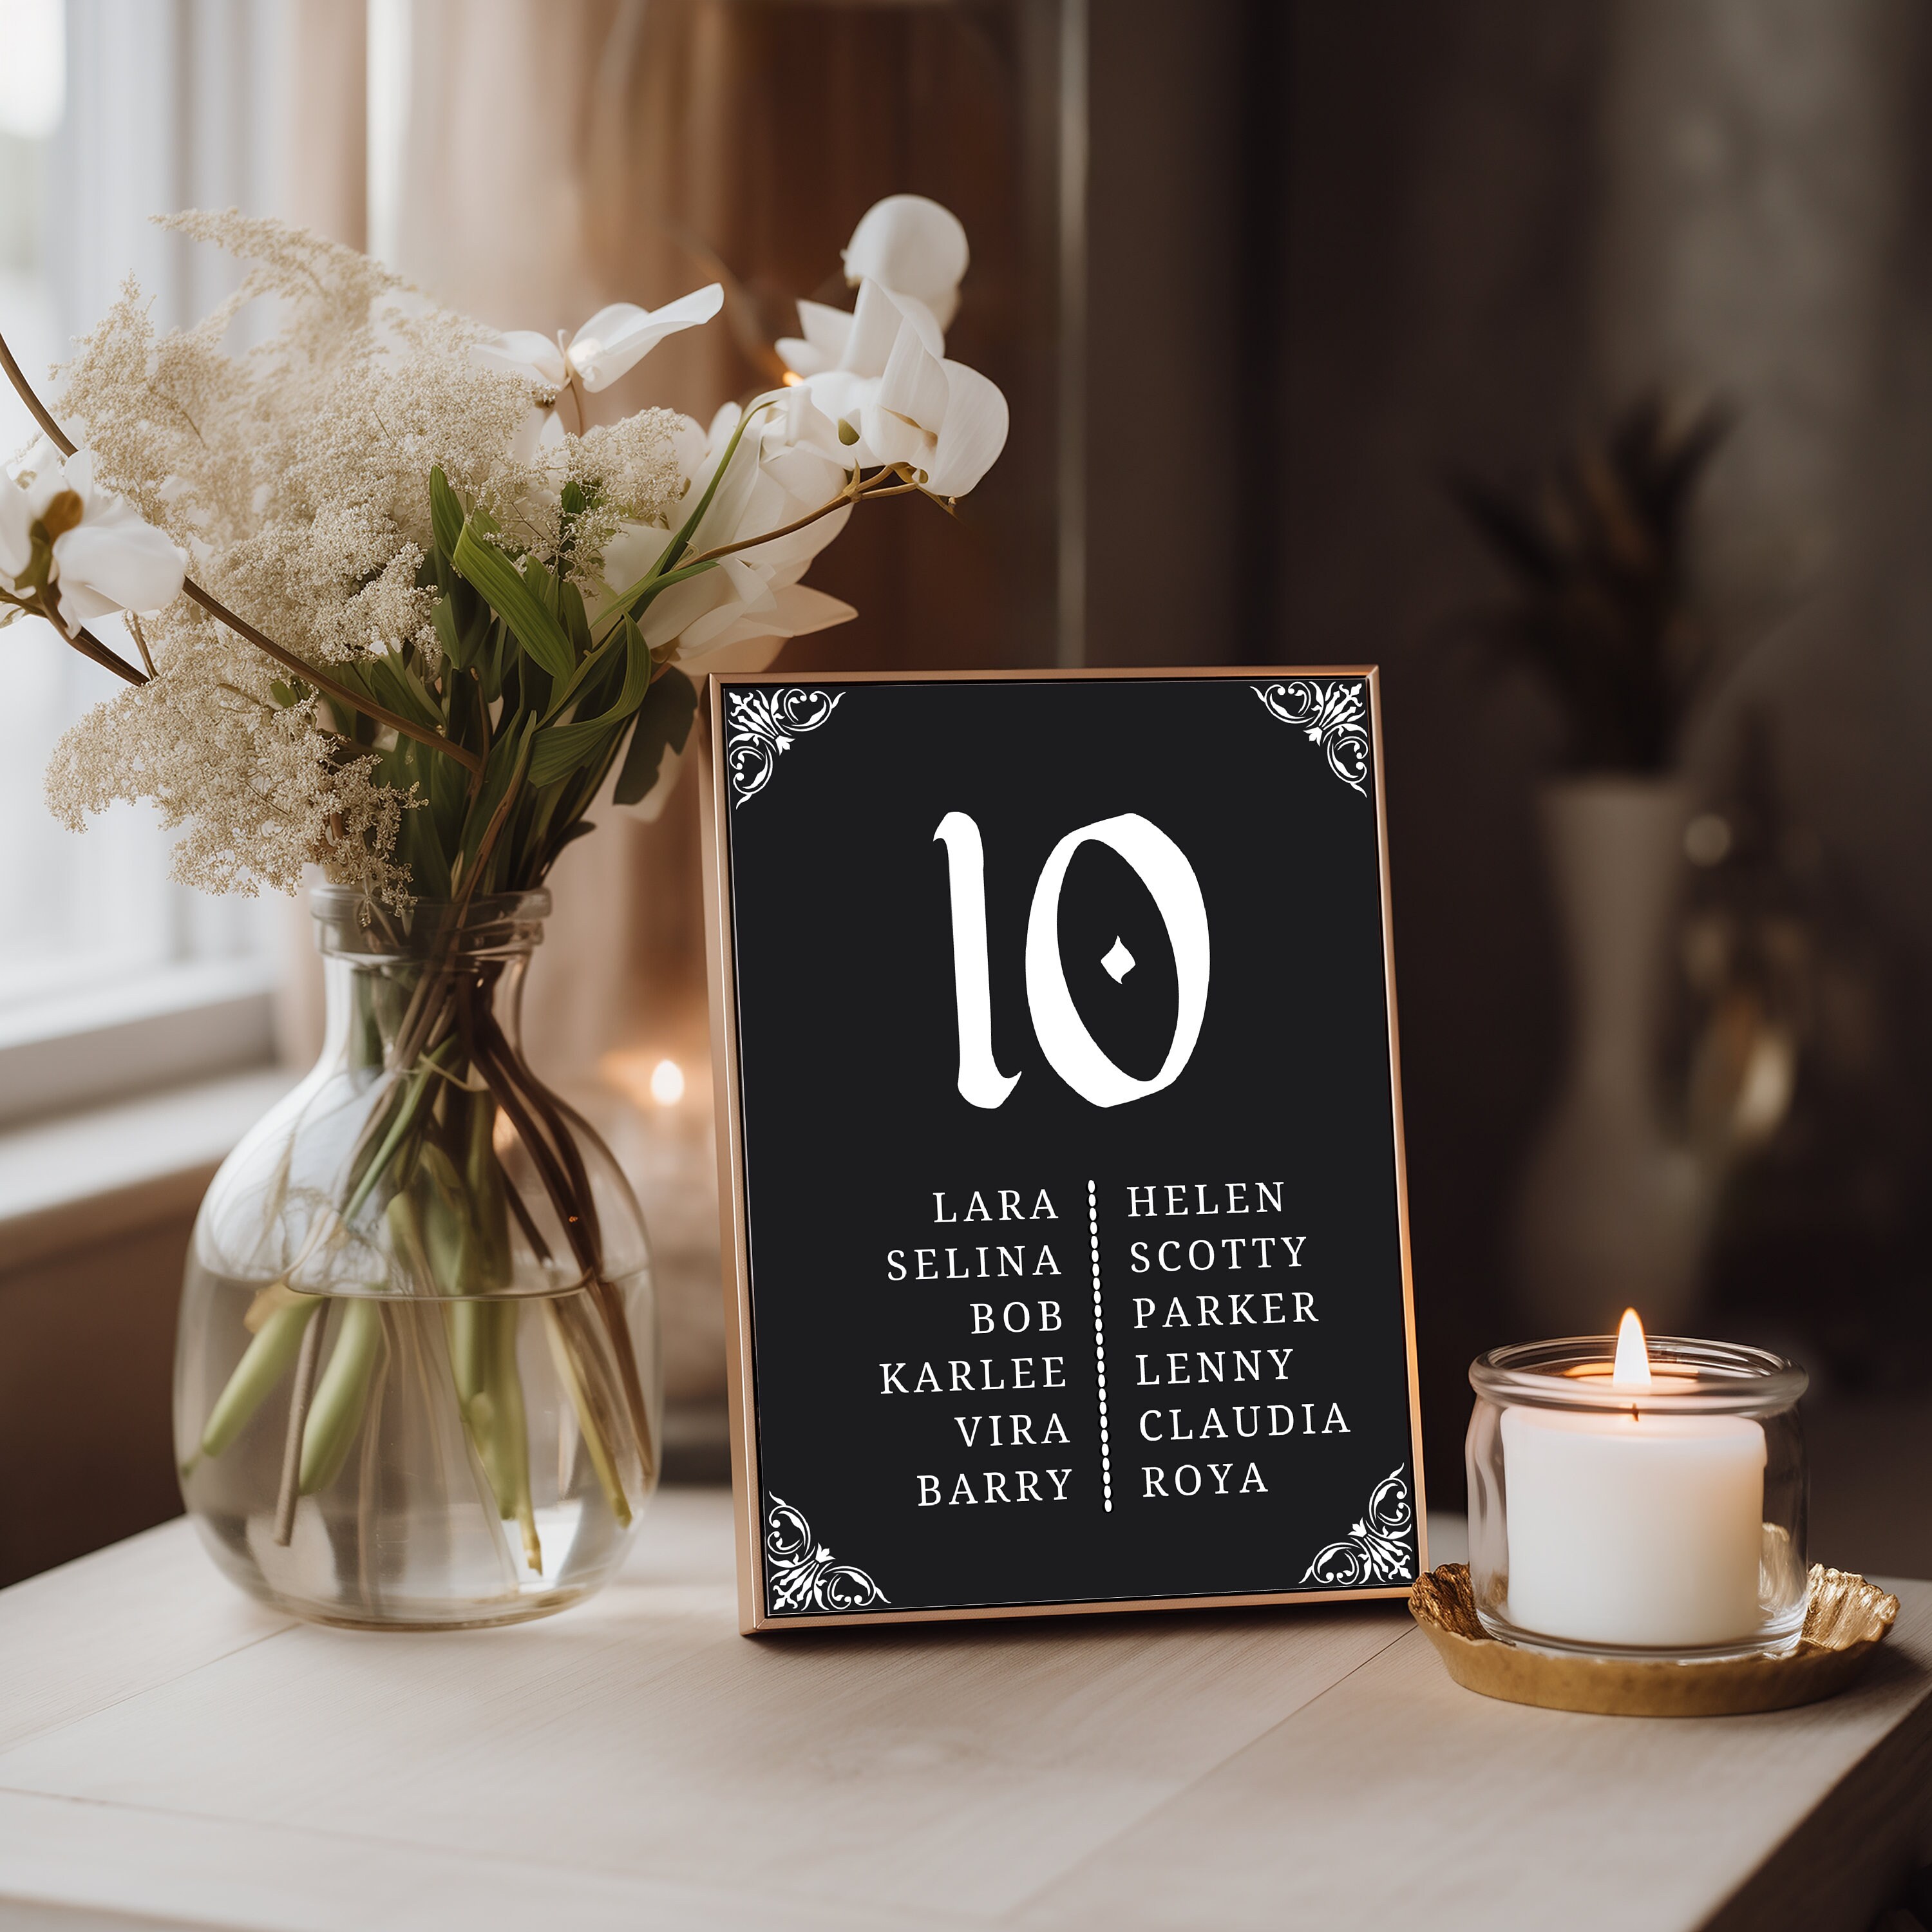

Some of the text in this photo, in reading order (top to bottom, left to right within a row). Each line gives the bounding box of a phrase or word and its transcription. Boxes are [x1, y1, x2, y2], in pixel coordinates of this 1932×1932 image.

[933, 812, 1210, 1109] 10
[933, 1189, 1058, 1222] LARA
[1127, 1182, 1283, 1217] HELEN
[887, 1245, 1061, 1280] SELINA
[1131, 1236, 1306, 1273] SCOTTY
[970, 1301, 1061, 1334] BOB
[1133, 1293, 1319, 1328] PARKER
[880, 1357, 1065, 1394] KARLEE
[1136, 1349, 1293, 1385] LENNY
[954, 1414, 1070, 1446] VIRA
[1140, 1403, 1350, 1441] CLAUDIA
[917, 1469, 1072, 1506] BARRY
[1142, 1463, 1268, 1497] ROYA
